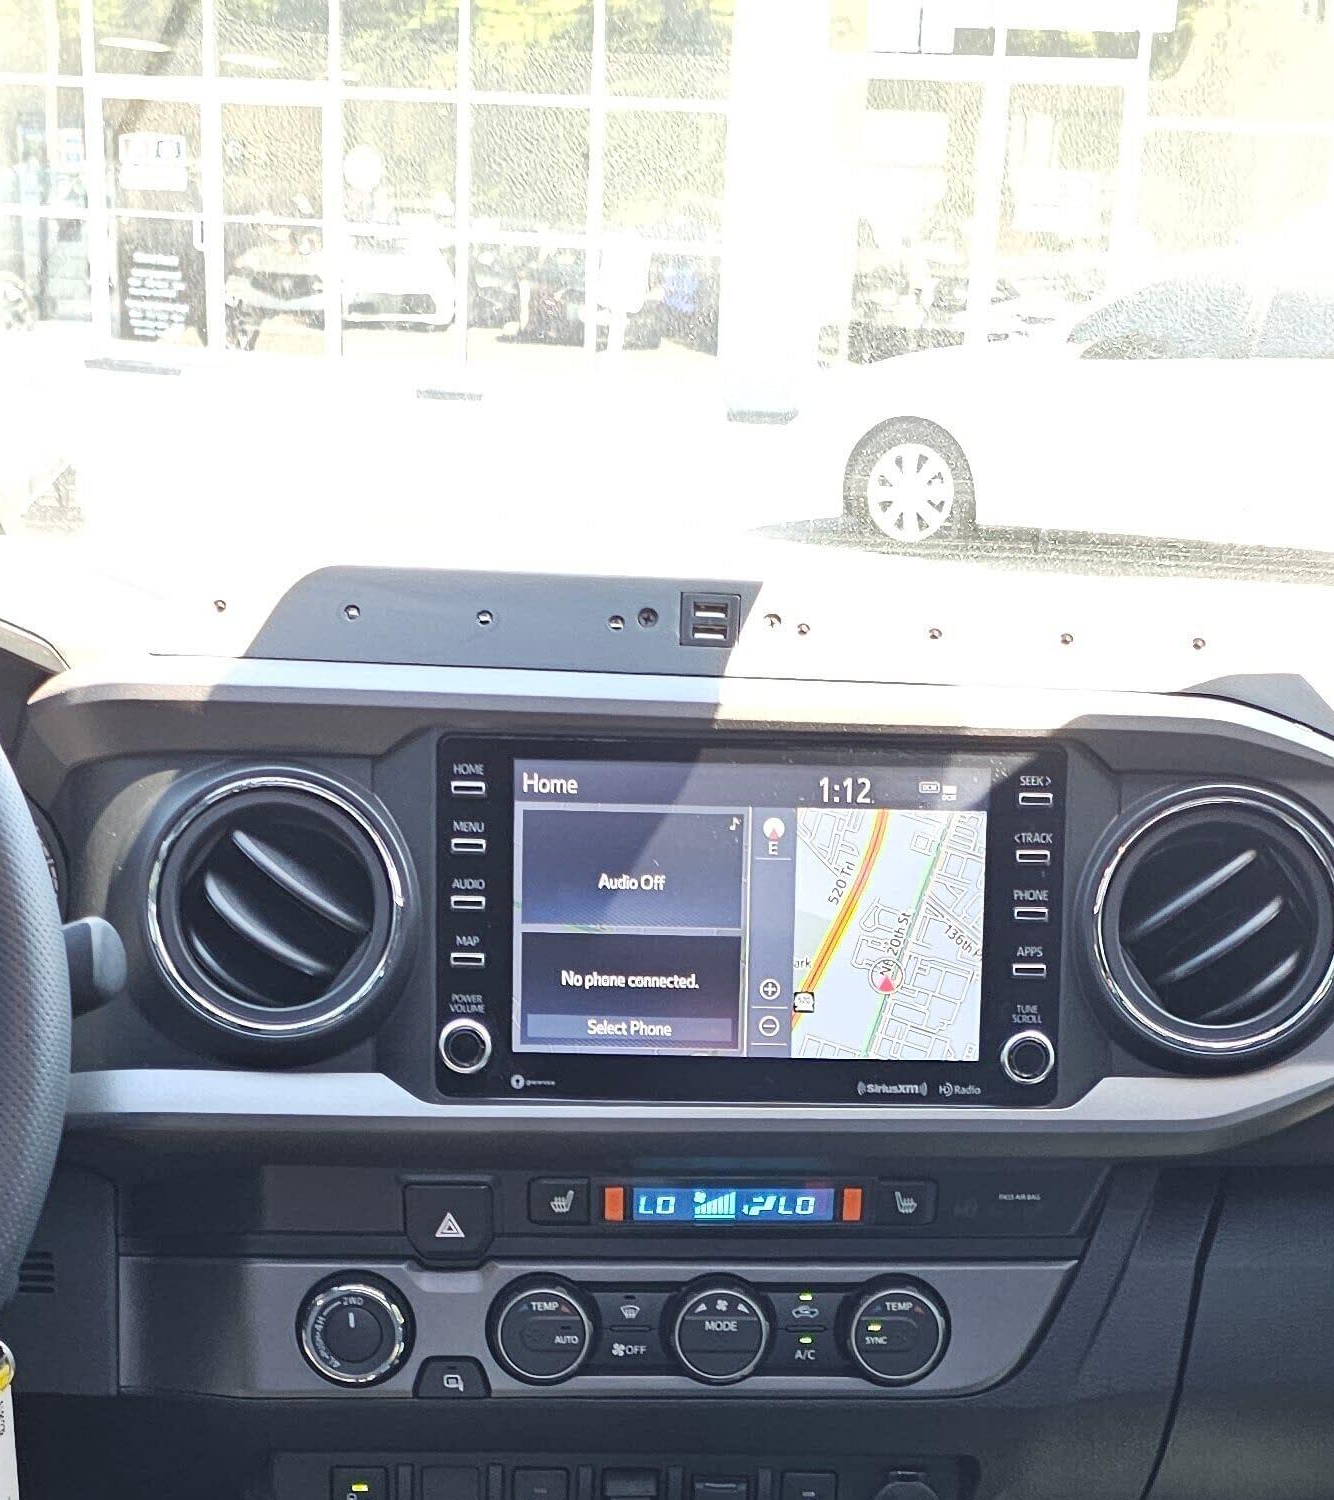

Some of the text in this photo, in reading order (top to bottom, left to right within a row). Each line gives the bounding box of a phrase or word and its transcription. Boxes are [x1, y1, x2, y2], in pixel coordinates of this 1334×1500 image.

[452, 763, 484, 775] HOME
[522, 772, 578, 795] Home
[819, 776, 871, 804] 1:12
[452, 821, 485, 833] MENU
[768, 842, 779, 856] E
[451, 878, 486, 890] AUDIO
[598, 873, 666, 891] Audio Off
[827, 861, 855, 906] 520 Trl
[1013, 889, 1049, 901] PHONE
[456, 936, 480, 947] MAP
[886, 926, 906, 956] 20th
[945, 924, 973, 953] 136th
[1016, 946, 1043, 958] APPS
[561, 970, 699, 990] No phone connected.
[451, 993, 483, 1003] POWER
[448, 1003, 486, 1013] VOLUME
[1017, 1004, 1038, 1014] TUNE
[1011, 1014, 1042, 1024] SCROLL
[587, 1019, 673, 1037] Select Phone
[954, 1085, 982, 1095] Radio
[342, 1296, 364, 1306] 2WD
[530, 1301, 559, 1311] TEMP
[885, 1301, 914, 1311] TEMP
[704, 1320, 738, 1332] MODE
[554, 1335, 579, 1345] AUTO
[865, 1336, 888, 1345] SYNC
[625, 1344, 647, 1355] OFF
[794, 1349, 816, 1360] A/C
